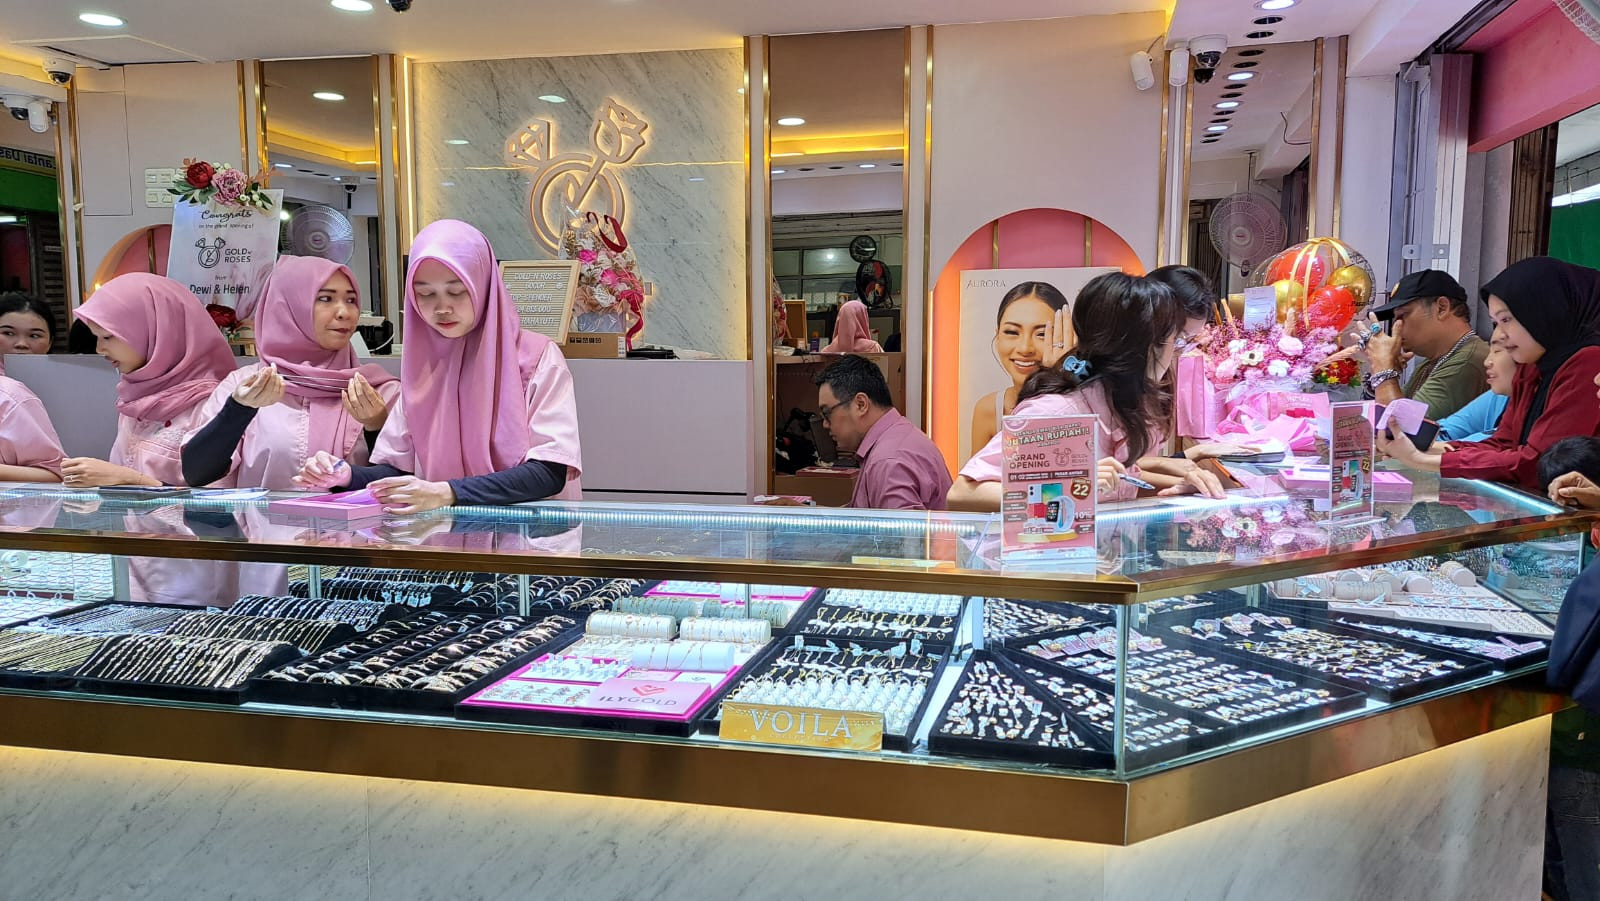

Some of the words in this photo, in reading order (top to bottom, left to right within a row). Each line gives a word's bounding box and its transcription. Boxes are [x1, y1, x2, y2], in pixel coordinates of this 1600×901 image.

[201, 209, 253, 222] Congrats
[224, 248, 248, 256] GOLD
[224, 255, 251, 264] ROSES
[189, 284, 212, 295] Dewi
[213, 284, 221, 295] &
[223, 283, 250, 295] Helen
[966, 279, 1006, 289] AURORA
[1008, 434, 1044, 447] JUTAAN
[1014, 452, 1046, 462] GRAND
[1009, 460, 1050, 470] OPENING
[1072, 483, 1090, 497] 22
[599, 694, 678, 707] ILYGOLD
[750, 707, 853, 738] VOILA
